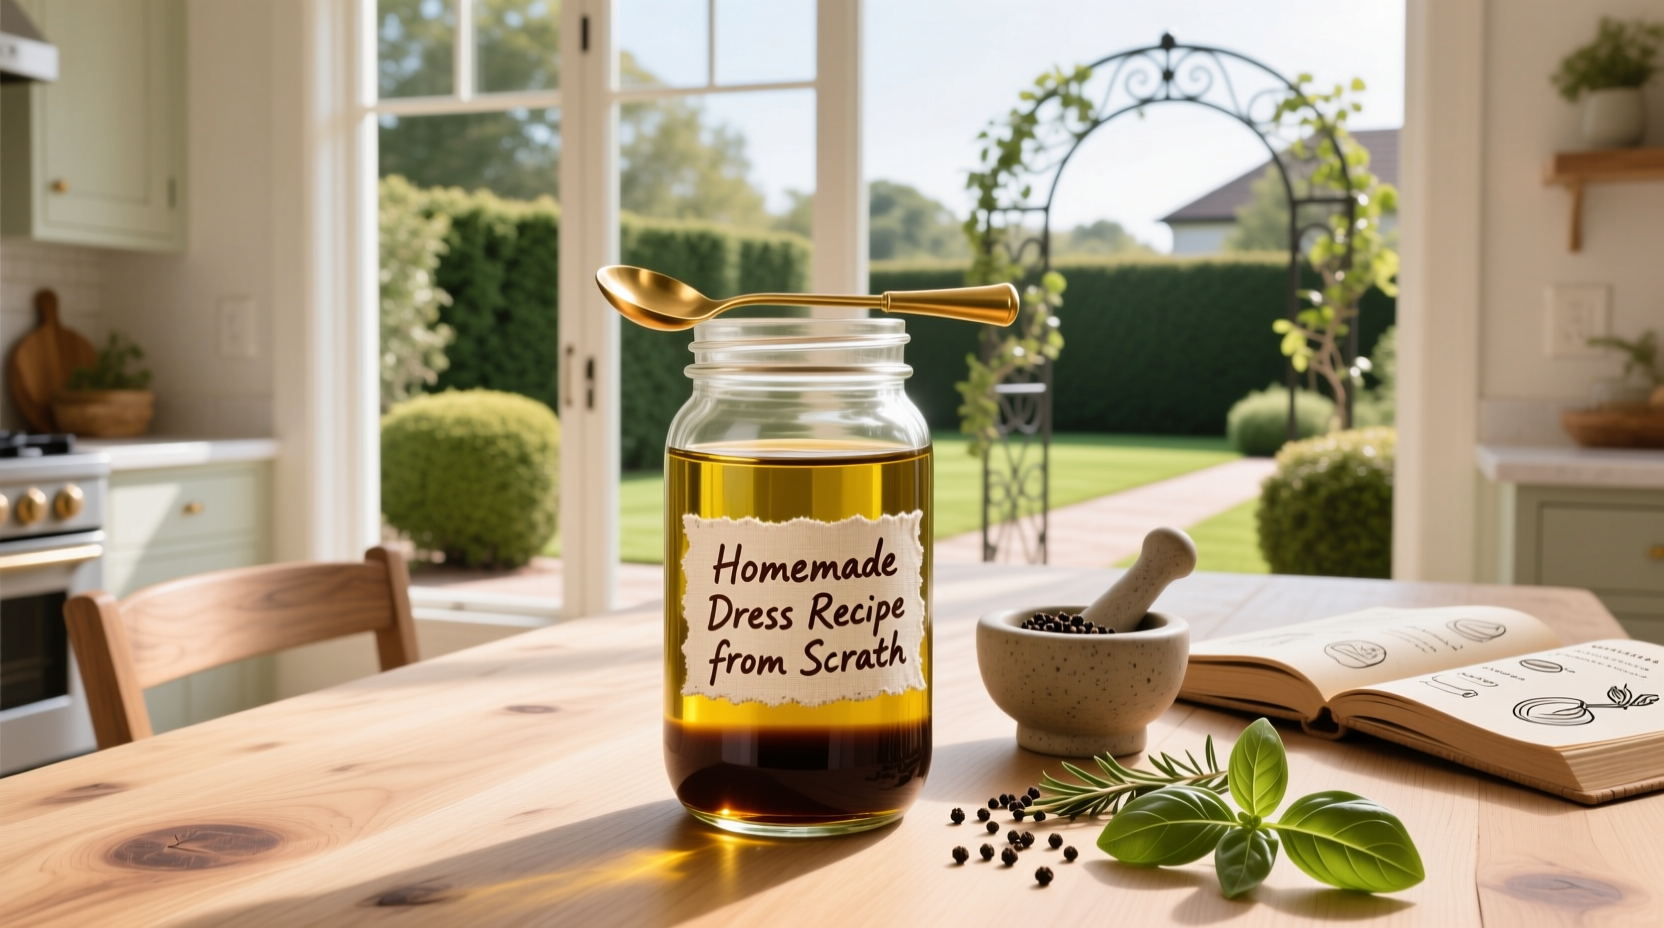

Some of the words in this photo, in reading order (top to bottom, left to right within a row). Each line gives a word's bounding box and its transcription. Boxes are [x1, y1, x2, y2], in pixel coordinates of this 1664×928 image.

[713, 537, 898, 584] Homemade
[708, 594, 794, 631] Dress
[808, 592, 905, 638] Recipe
[709, 639, 788, 686] from
[799, 630, 907, 677] Scrath
